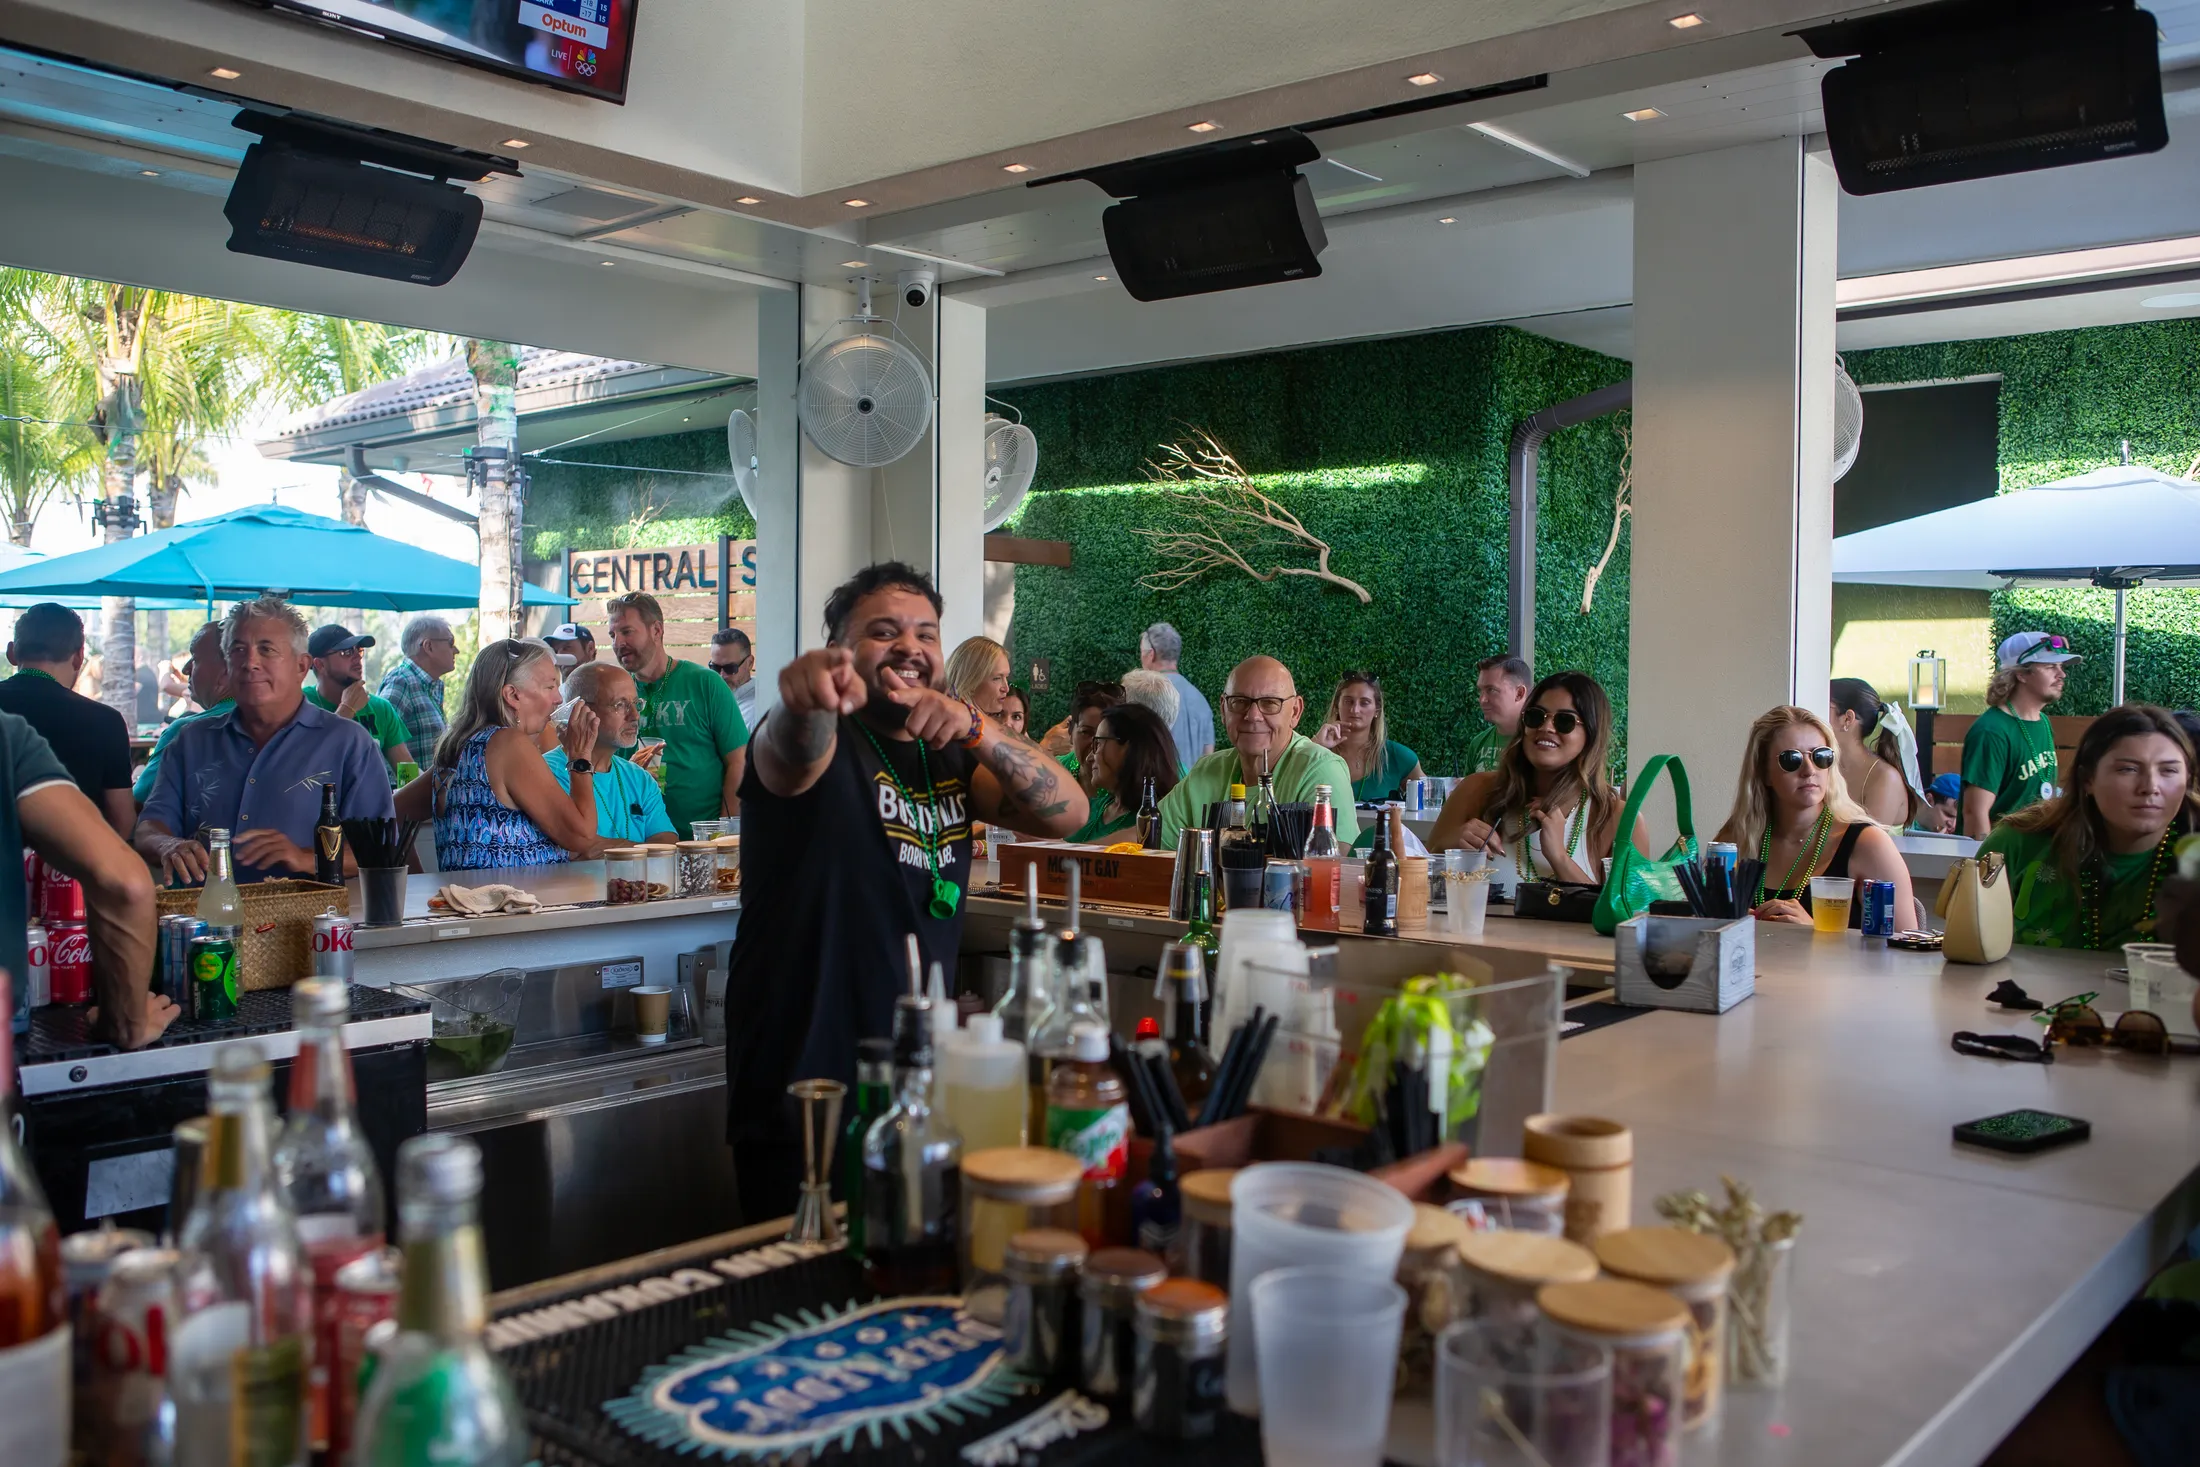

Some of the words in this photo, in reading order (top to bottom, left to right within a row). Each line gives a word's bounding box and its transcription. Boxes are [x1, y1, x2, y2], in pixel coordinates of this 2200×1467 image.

[600, 3, 608, 12] 15
[322, 11, 341, 20] SONY
[581, 10, 593, 18] -17
[598, 14, 606, 23] 15
[541, 13, 587, 38] Optum
[551, 49, 568, 61] LIVE
[572, 549, 717, 595] CENTRAL
[1047, 854, 1092, 875] MONT
[1094, 859, 1121, 879] GAY
[310, 925, 354, 953] oke
